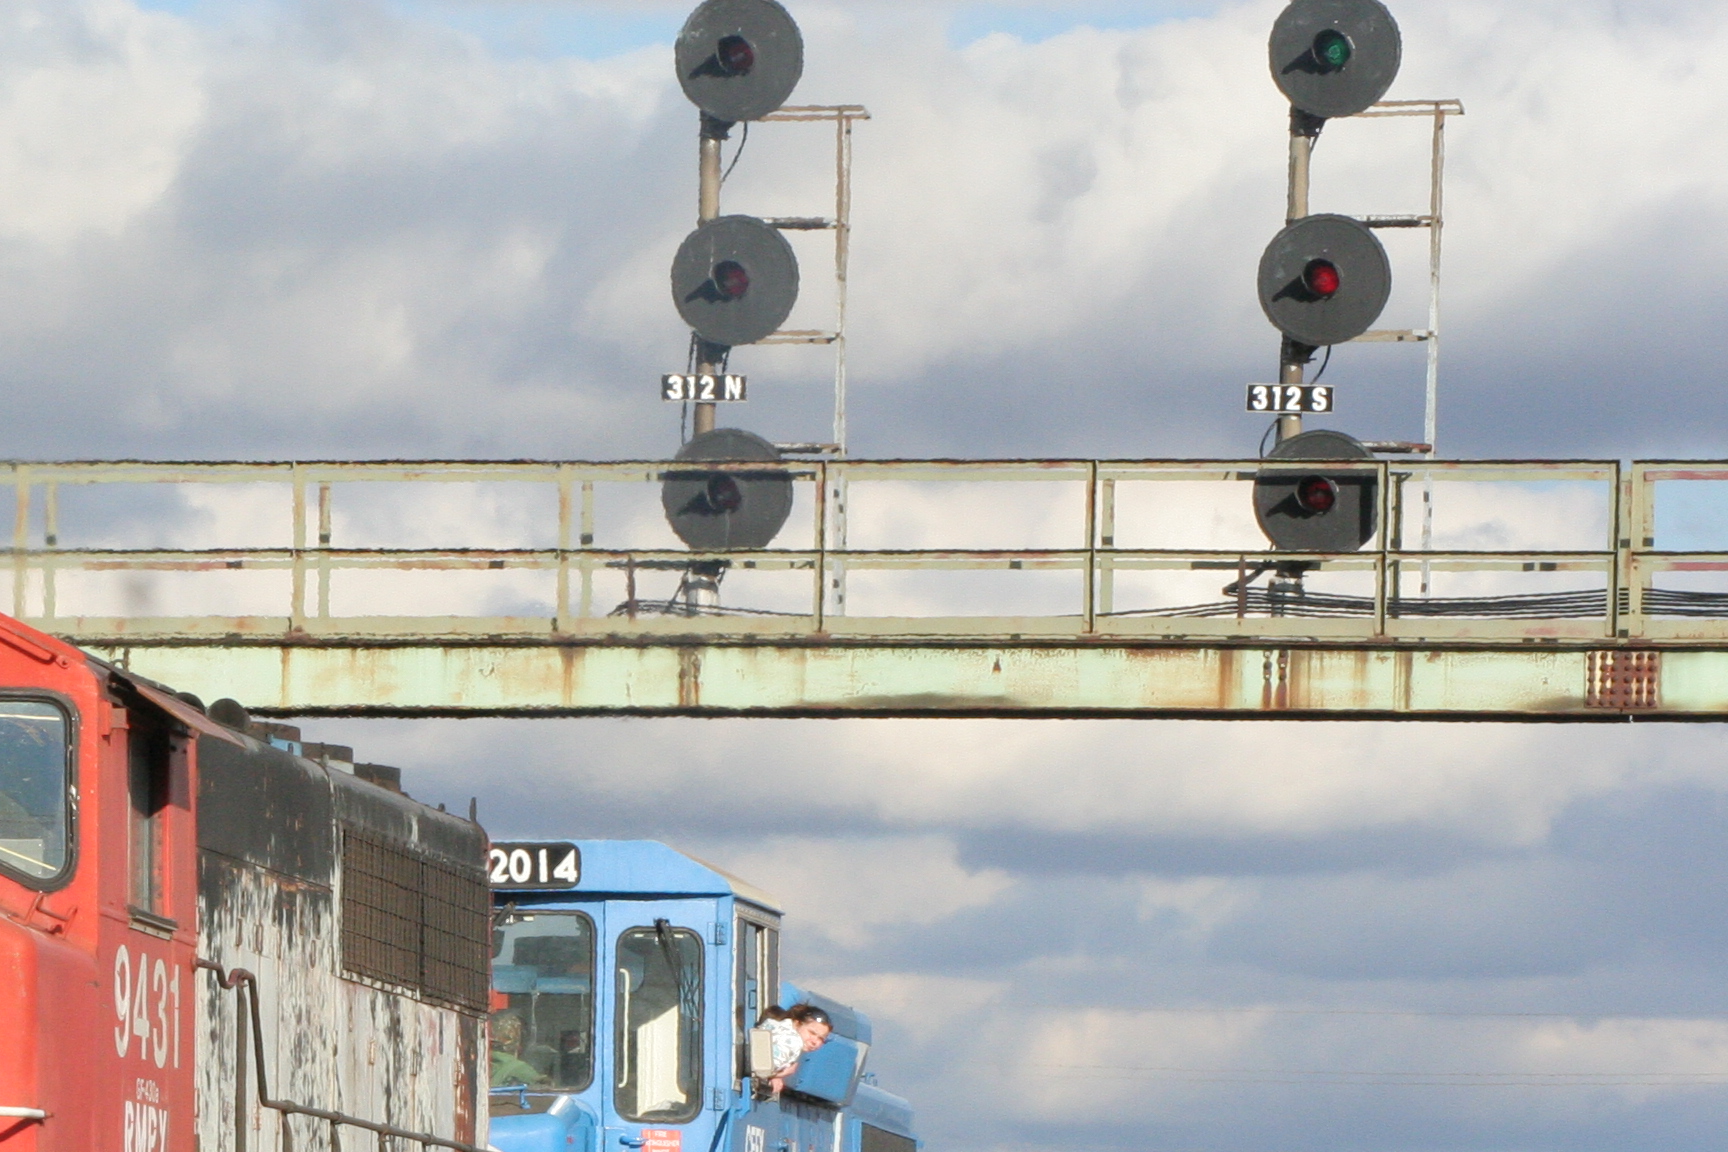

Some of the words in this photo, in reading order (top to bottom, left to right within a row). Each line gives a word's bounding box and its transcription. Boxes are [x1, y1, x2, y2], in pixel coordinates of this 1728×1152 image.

[667, 375, 715, 399] 312
[724, 375, 742, 399] N
[1252, 386, 1302, 410] 312
[1311, 387, 1328, 411] S
[489, 848, 578, 883] 2014
[114, 944, 179, 1069] 9431
